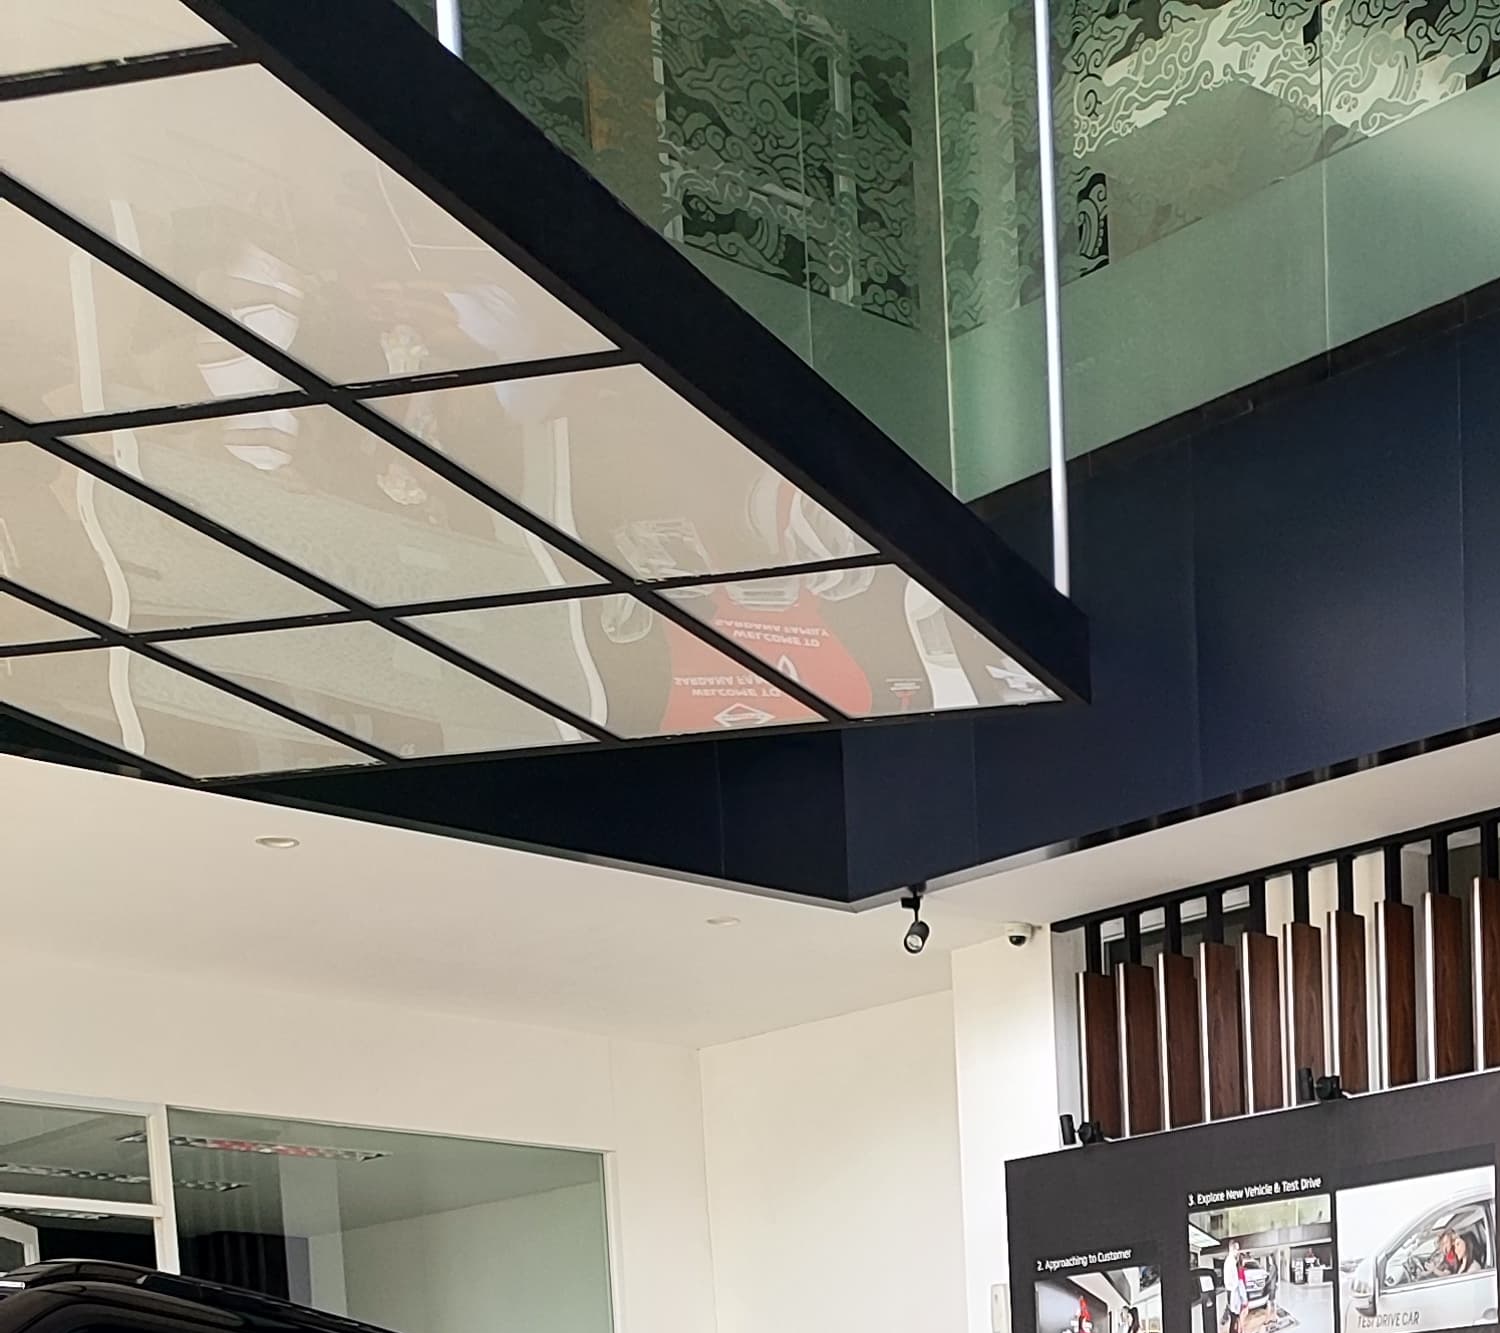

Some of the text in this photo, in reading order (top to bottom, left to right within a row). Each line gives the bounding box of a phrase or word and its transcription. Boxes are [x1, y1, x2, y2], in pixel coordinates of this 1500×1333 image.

[1197, 1192, 1225, 1206] Explore
[1226, 1189, 1244, 1200] New
[1244, 1184, 1273, 1198] Vehicle
[1274, 1182, 1281, 1193] &
[1281, 1180, 1300, 1193] Test
[1300, 1177, 1322, 1191] Drive
[1037, 1249, 1132, 1272] 2. Approaching to Customer
[1376, 1313, 1401, 1328] DRIVE
[1402, 1311, 1420, 1326] CAR
